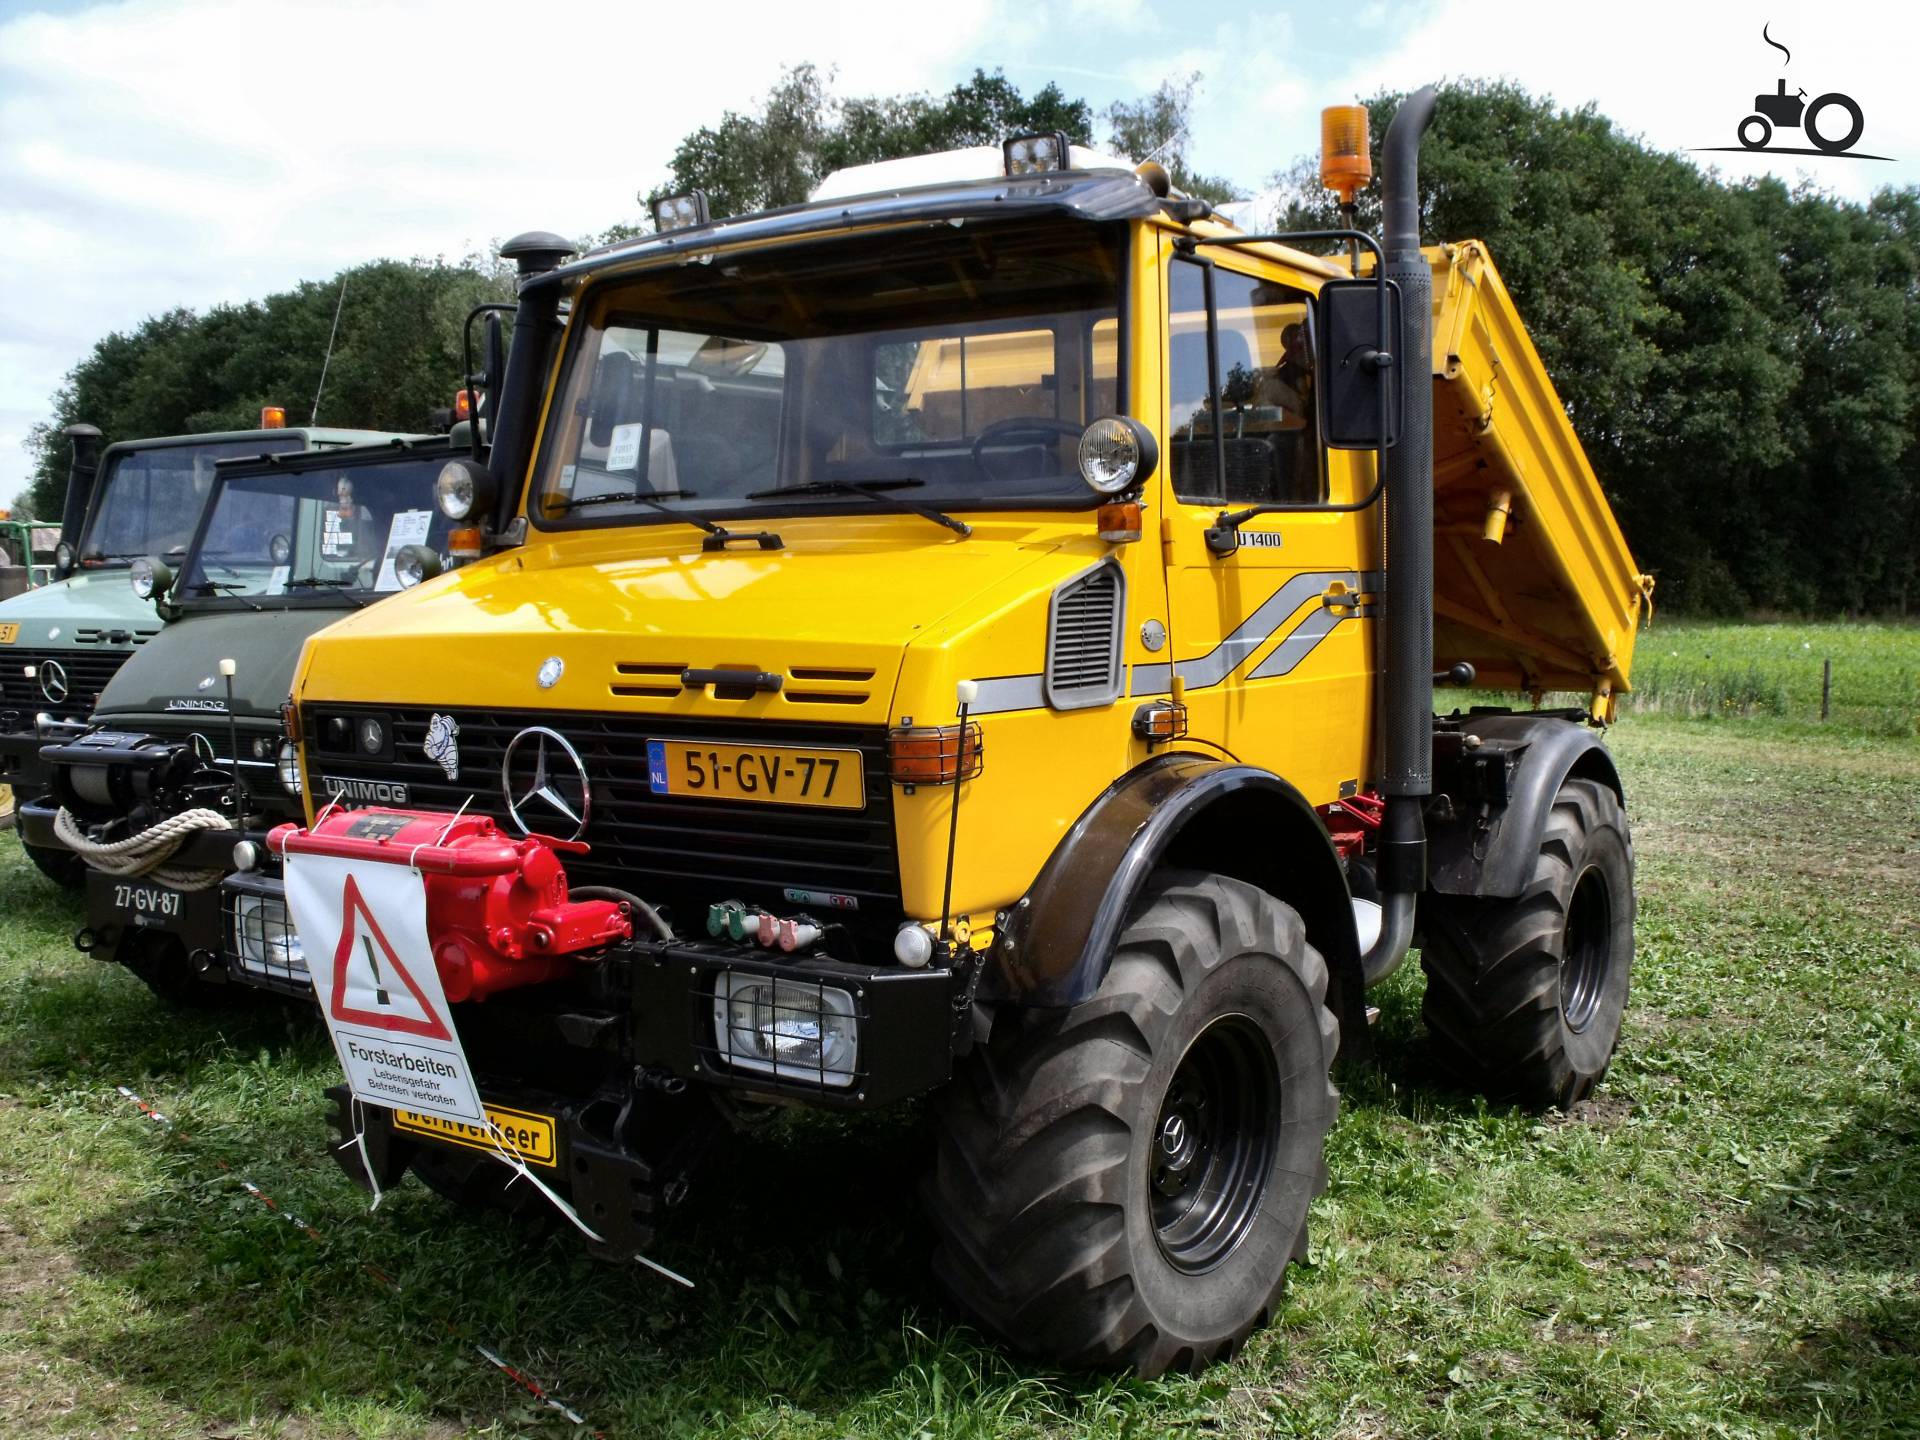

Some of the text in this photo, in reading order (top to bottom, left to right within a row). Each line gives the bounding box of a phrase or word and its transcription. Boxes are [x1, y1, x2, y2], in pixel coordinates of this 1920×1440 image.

[1250, 533, 1281, 547] 1400
[169, 699, 225, 710] UNIMOG
[651, 771, 666, 785] NL
[685, 750, 840, 798] 51-GV-77
[325, 779, 406, 803] UNIMOG
[114, 884, 180, 916] 27-GV-87
[348, 1041, 457, 1079] Forstarbeiten
[373, 1067, 441, 1091] Lebensgefahr
[367, 1078, 457, 1106] Betreten verboten
